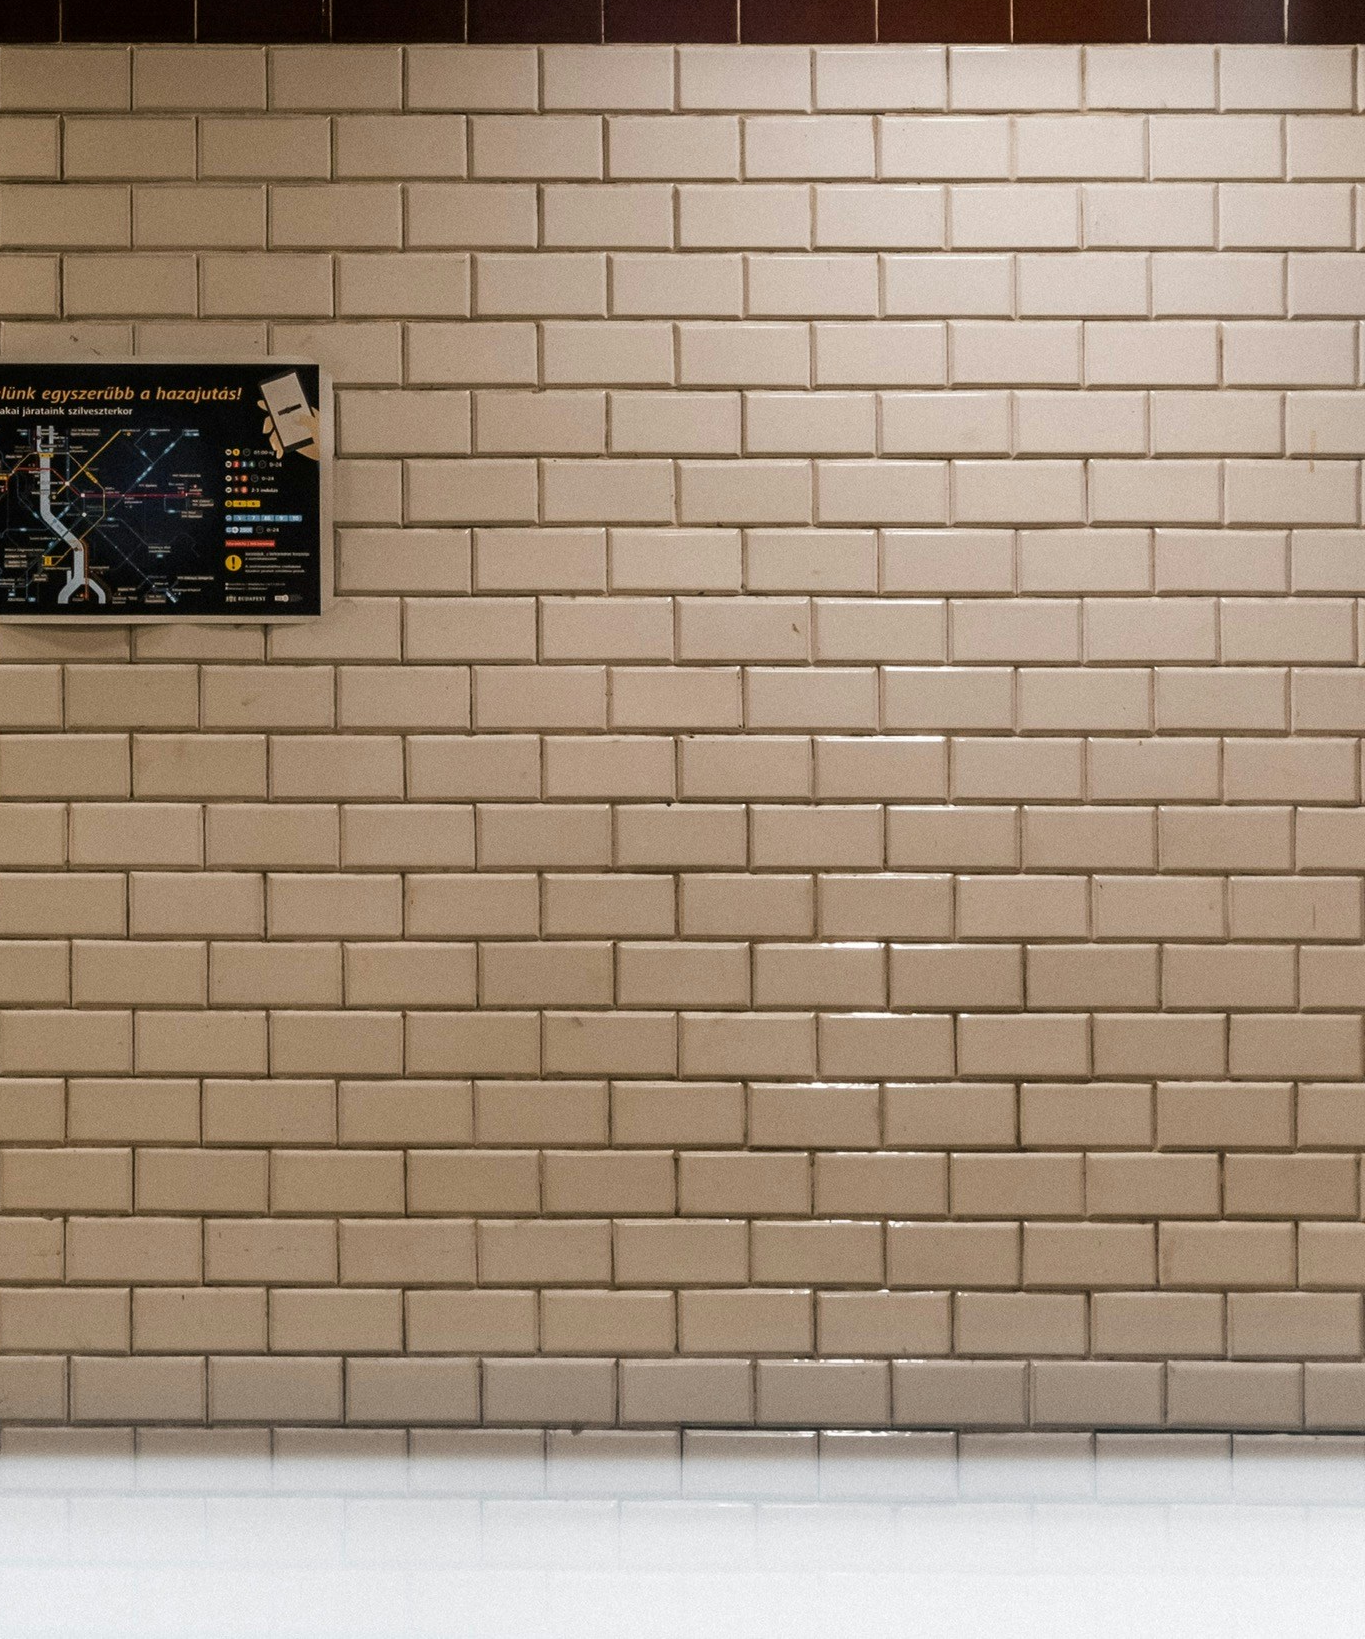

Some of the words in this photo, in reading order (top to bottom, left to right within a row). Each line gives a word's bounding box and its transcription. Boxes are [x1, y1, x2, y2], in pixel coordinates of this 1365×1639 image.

[41, 386, 135, 404] egyszerűbb
[140, 391, 150, 401] a
[156, 386, 243, 404] hazajutás!
[21, 406, 65, 417] járataink
[68, 406, 133, 416] szilveszterkor
